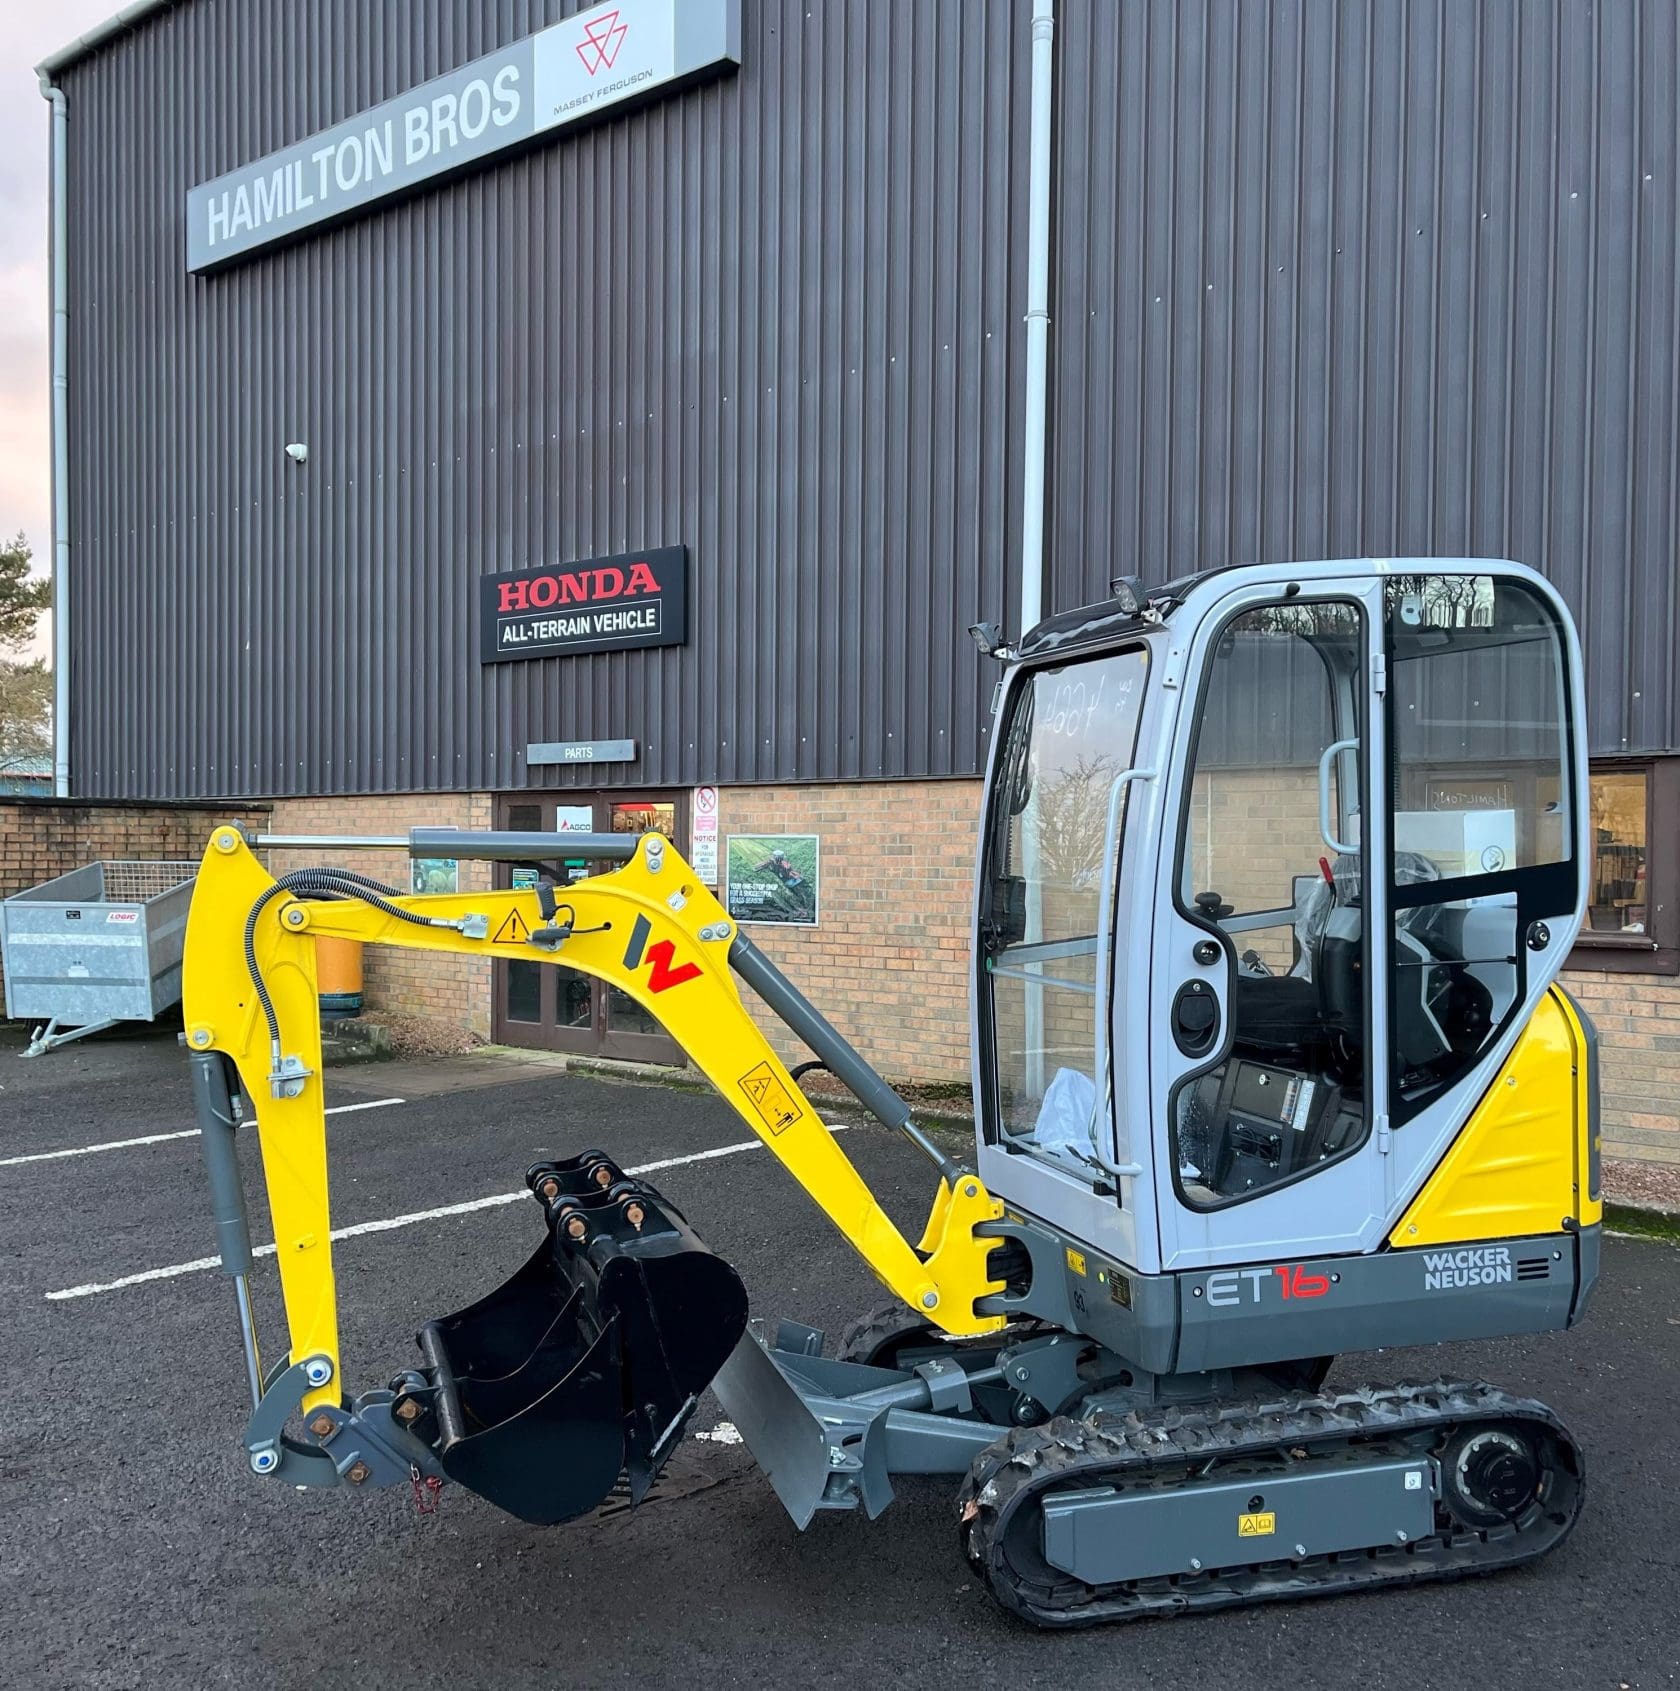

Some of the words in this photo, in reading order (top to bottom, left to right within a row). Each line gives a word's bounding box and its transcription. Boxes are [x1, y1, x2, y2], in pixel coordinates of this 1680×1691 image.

[553, 92, 595, 115] MASSEY
[596, 69, 653, 98] FERGUSON
[208, 119, 393, 247] HAMILTON
[405, 64, 521, 166] BROS
[498, 562, 661, 612] HONDA
[503, 616, 591, 643] ALL-TERRAIN
[594, 608, 656, 633] VEHICLE
[564, 747, 593, 759] PARTS
[569, 823, 591, 831] AGCO
[1423, 1247, 1512, 1272] WACKER
[1206, 1265, 1330, 1308] ET16
[1424, 1265, 1512, 1290] NEUSON
